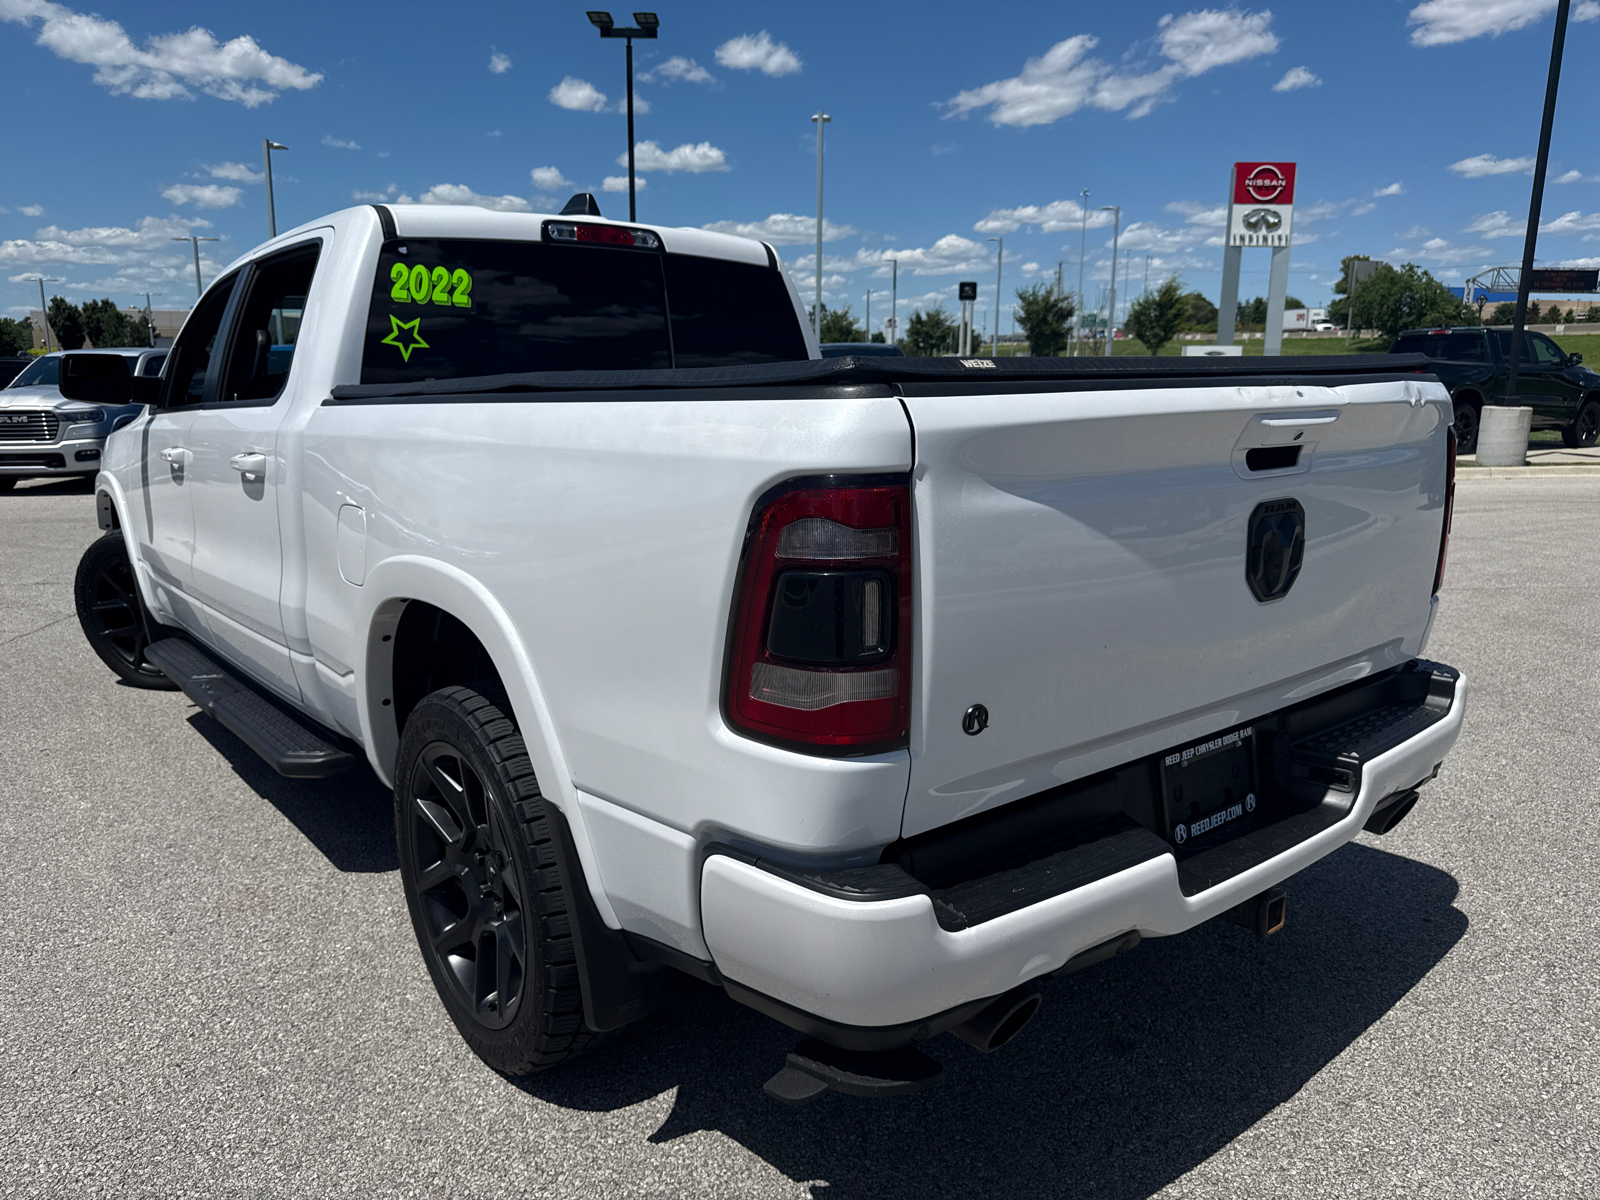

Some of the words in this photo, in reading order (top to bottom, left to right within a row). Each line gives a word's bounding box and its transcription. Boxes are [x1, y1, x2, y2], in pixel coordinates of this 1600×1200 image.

[1245, 179, 1286, 187] NISSAN
[1233, 234, 1288, 244] INFINITI
[390, 262, 472, 308] 2022
[960, 359, 996, 368] WEIZE
[0, 415, 28, 423] AM
[1264, 501, 1297, 514] RAM
[1165, 753, 1180, 766] REED
[1181, 748, 1195, 761] JEEP
[1195, 738, 1222, 755] CHRYSLER
[1222, 733, 1240, 746] DODGE
[1239, 727, 1252, 740] RAM
[1190, 803, 1242, 837] REEDJEEP.COM
